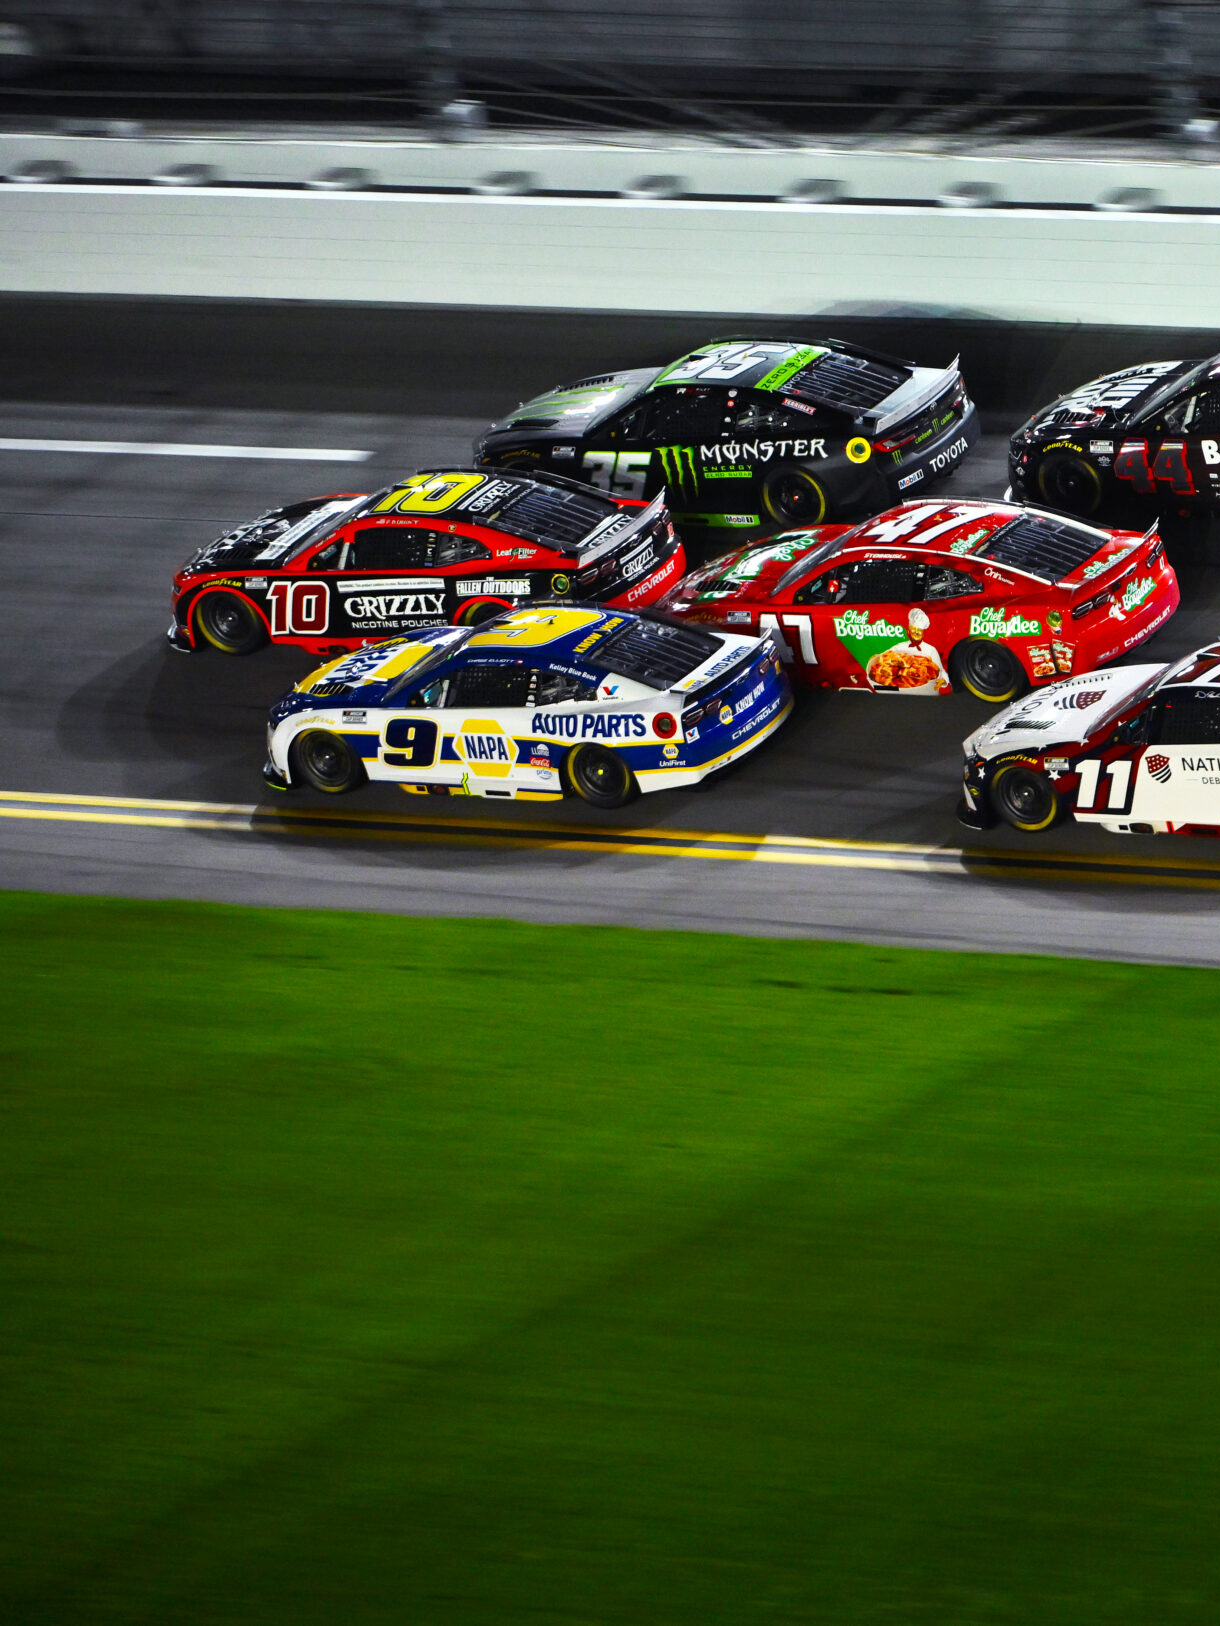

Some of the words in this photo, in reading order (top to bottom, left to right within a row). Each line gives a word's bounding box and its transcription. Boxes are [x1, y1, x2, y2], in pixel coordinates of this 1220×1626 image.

[761, 368, 787, 389] ZERO
[780, 371, 809, 392] TOYOTA
[929, 436, 969, 472] TOYOTA
[1042, 440, 1083, 453] GOODYEAR
[582, 450, 652, 501] 35
[1114, 437, 1197, 495] 44
[369, 472, 489, 514] 10
[899, 474, 916, 489] Mobil
[725, 515, 745, 524] Mobil
[861, 503, 996, 545] 47
[496, 548, 513, 557] Leaf
[622, 543, 654, 577] GRIZZLY
[202, 577, 243, 588] GOODYEAR
[456, 582, 482, 595] FALLEN
[483, 580, 532, 594] OUTDOORS
[627, 559, 675, 602] CHEVROLET
[266, 580, 330, 636] 10
[343, 593, 446, 620] GRIZZLY
[844, 608, 869, 625] Chef
[979, 607, 1005, 622] Chef
[352, 621, 398, 629] NICOTINE
[401, 619, 449, 628] POUCHES
[833, 616, 906, 640] Boyardee
[970, 613, 1041, 638] Boyardee
[1123, 605, 1171, 648] CHEVROLET
[573, 632, 603, 654] KNOW
[549, 663, 568, 674] Kelley
[568, 667, 582, 677] Blue
[582, 671, 598, 682] Book
[704, 660, 726, 678] AUTO
[734, 697, 754, 714] KNOW
[532, 713, 579, 738] AUTO
[581, 713, 647, 738] PARTS
[731, 697, 781, 741] CHEVROLET
[379, 715, 442, 770] 9
[463, 735, 510, 761] NAPA
[659, 760, 686, 768] UniFirst
[995, 753, 1038, 765] GOODYEAR
[1074, 758, 1133, 810] 11
